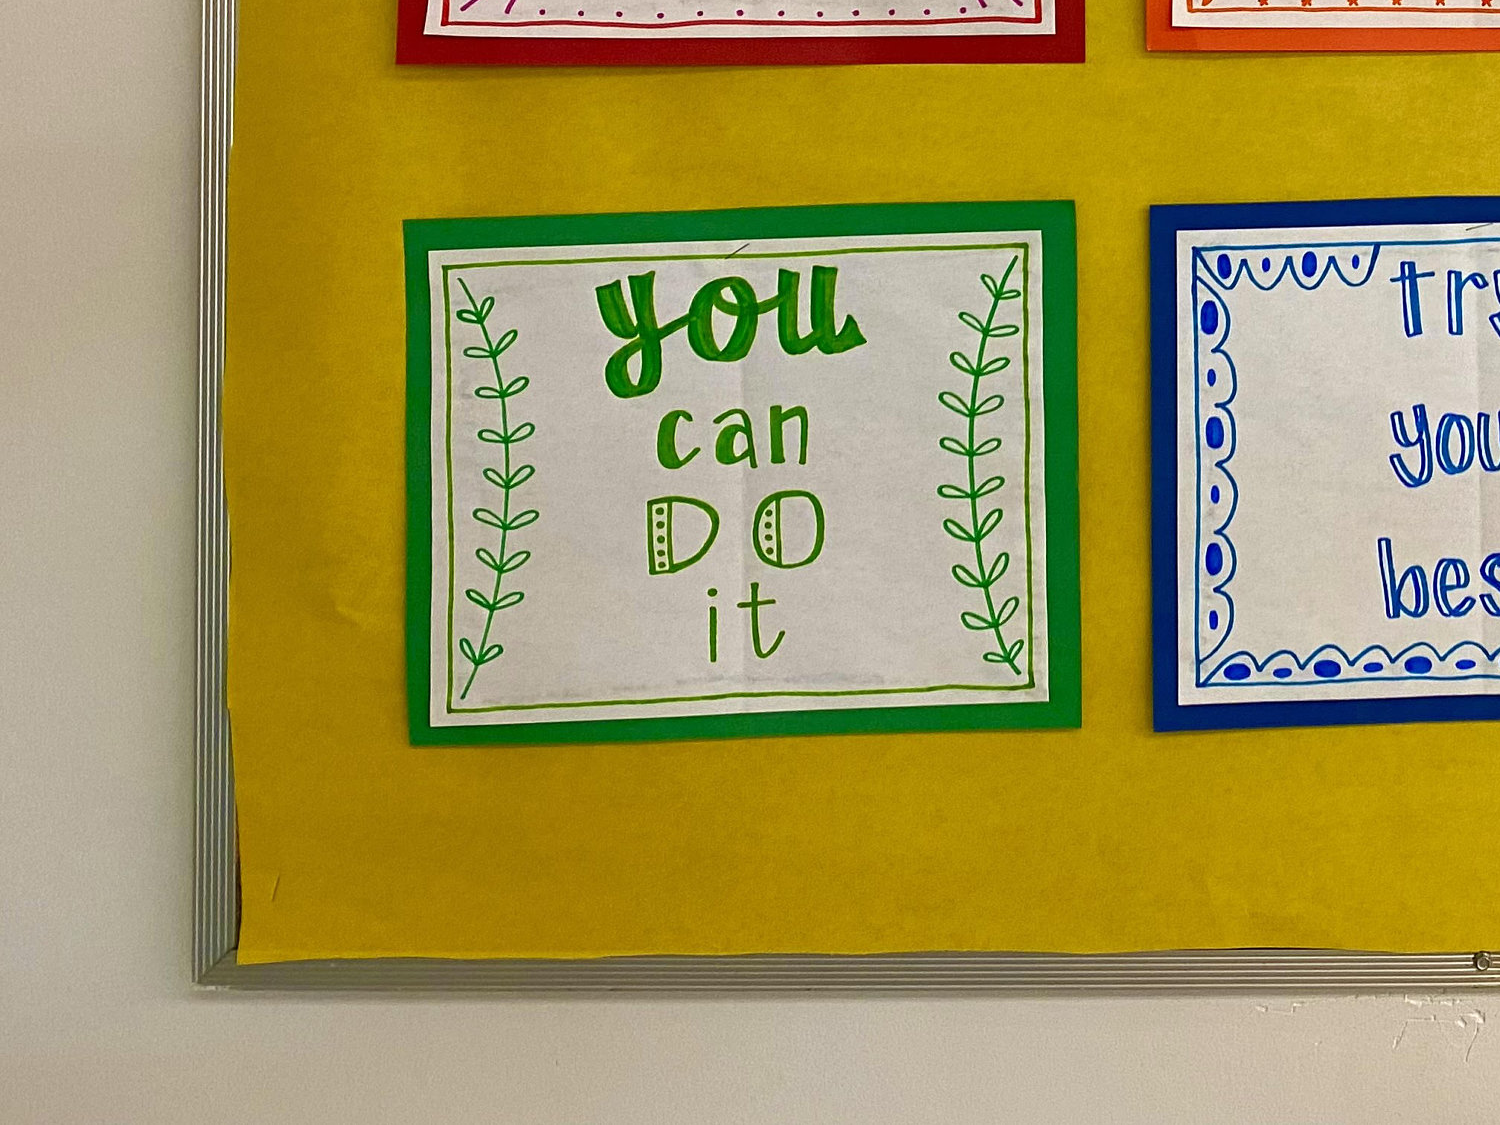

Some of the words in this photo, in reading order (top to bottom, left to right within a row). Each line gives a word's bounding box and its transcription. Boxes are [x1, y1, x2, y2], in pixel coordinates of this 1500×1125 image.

[594, 264, 867, 399] you
[657, 405, 808, 469] can
[647, 490, 825, 575] DO
[708, 582, 785, 662] it
